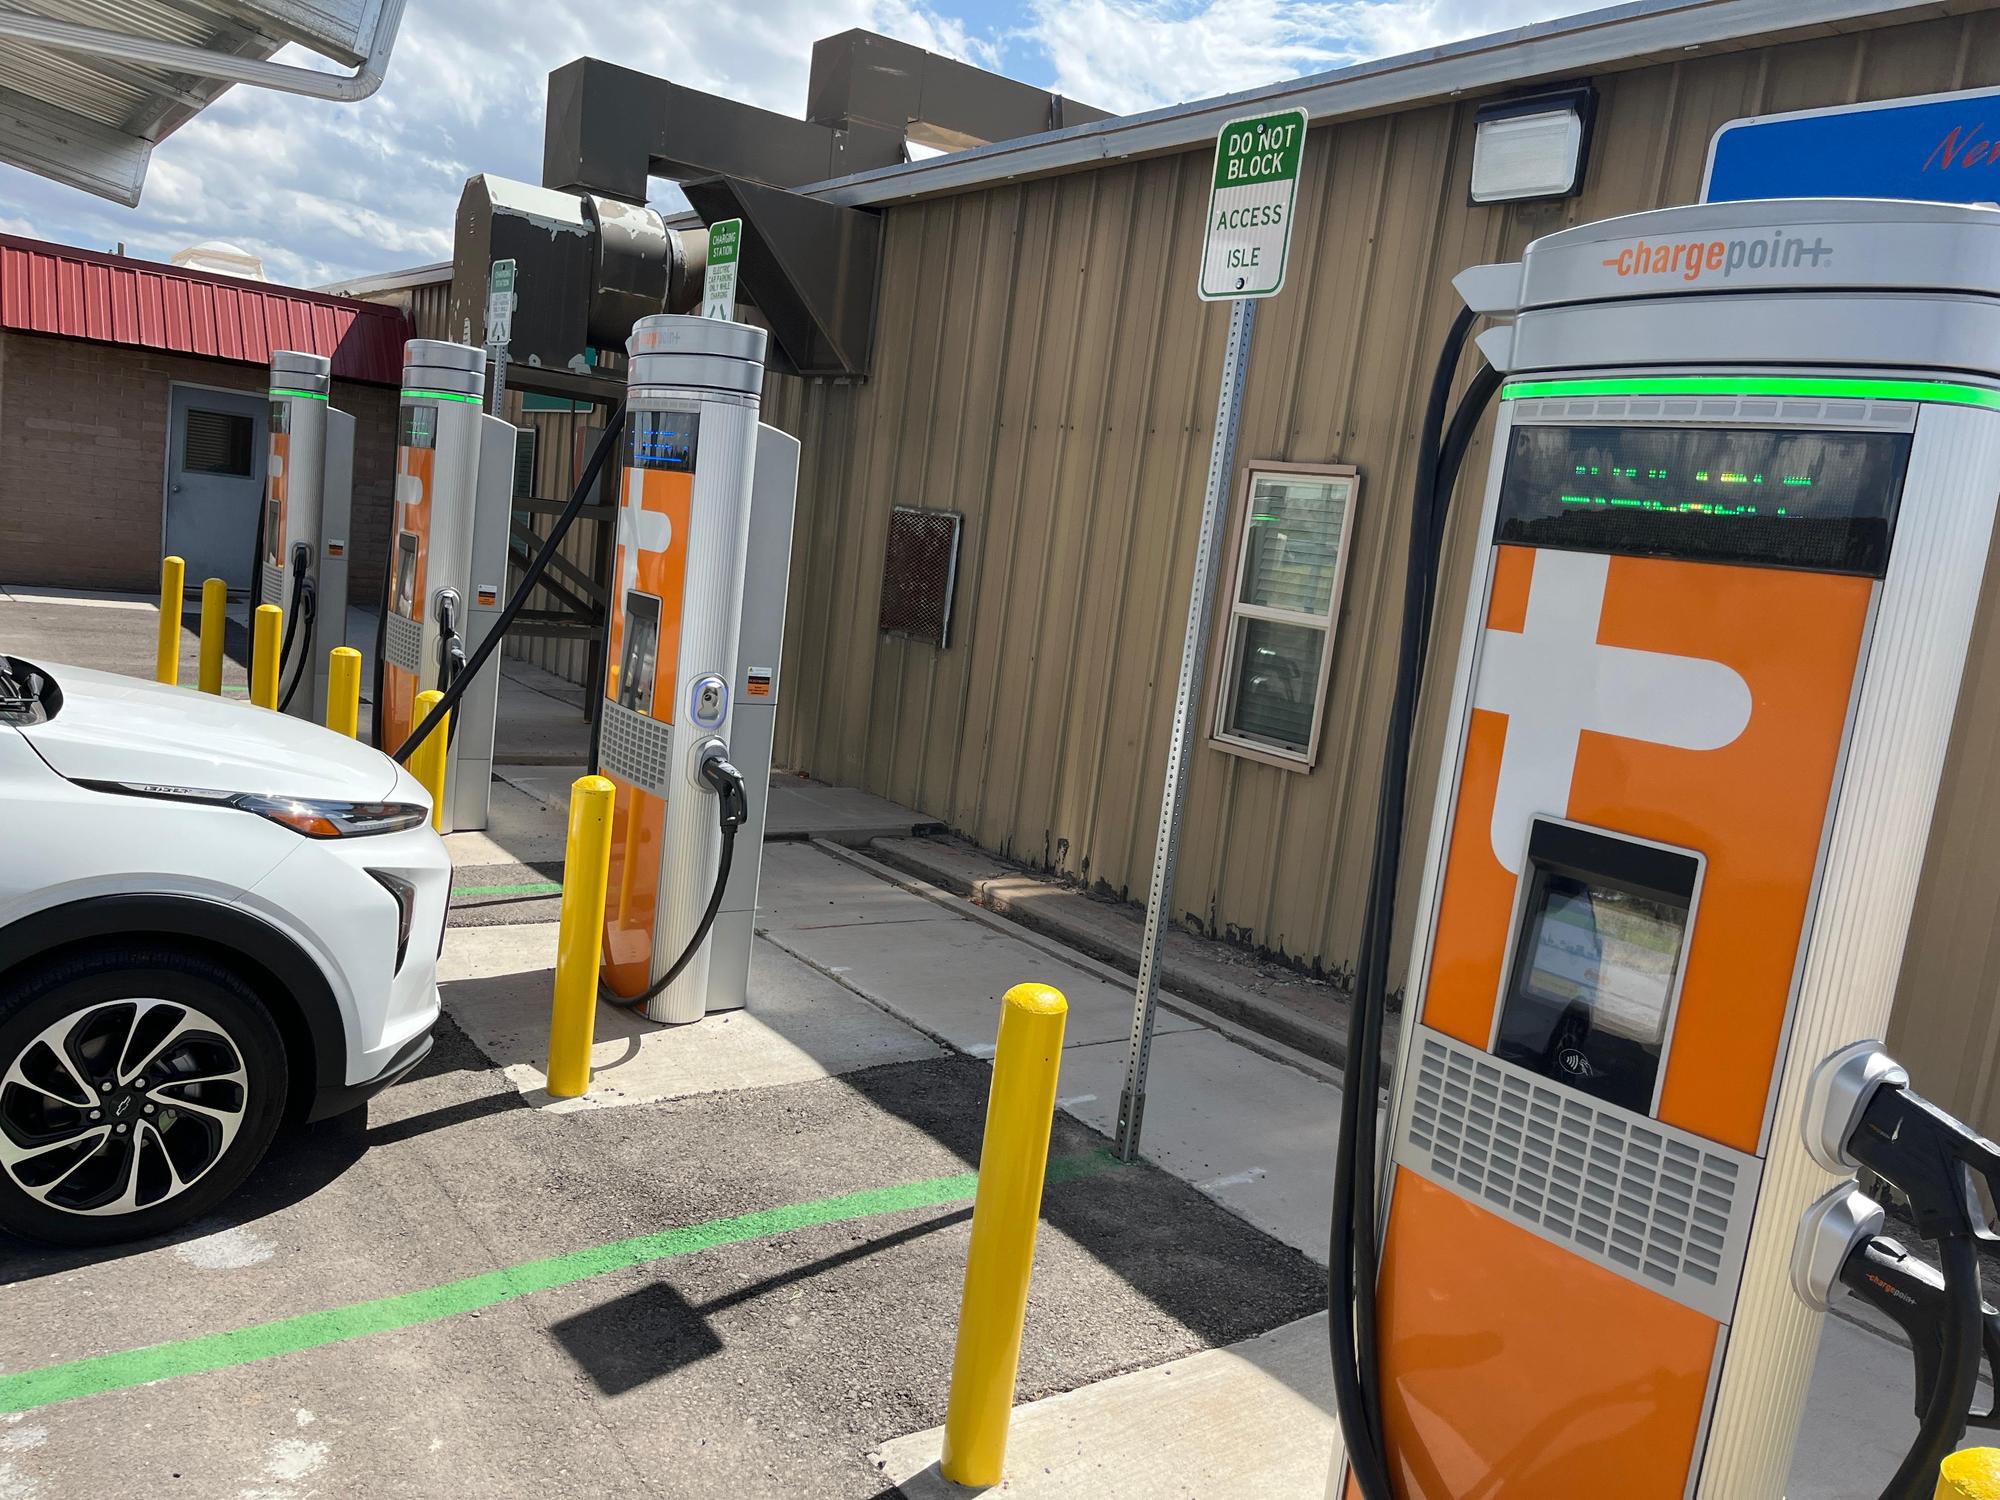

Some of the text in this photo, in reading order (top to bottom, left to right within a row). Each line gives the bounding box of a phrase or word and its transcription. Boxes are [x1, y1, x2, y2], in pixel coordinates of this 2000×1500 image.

[1228, 124, 1296, 157] DO NOT
[1227, 152, 1284, 180] BLOCK
[1216, 204, 1282, 231] ACCESS
[712, 232, 736, 246] CHARGING
[713, 245, 733, 258] STATION
[1227, 247, 1260, 269] ISLE
